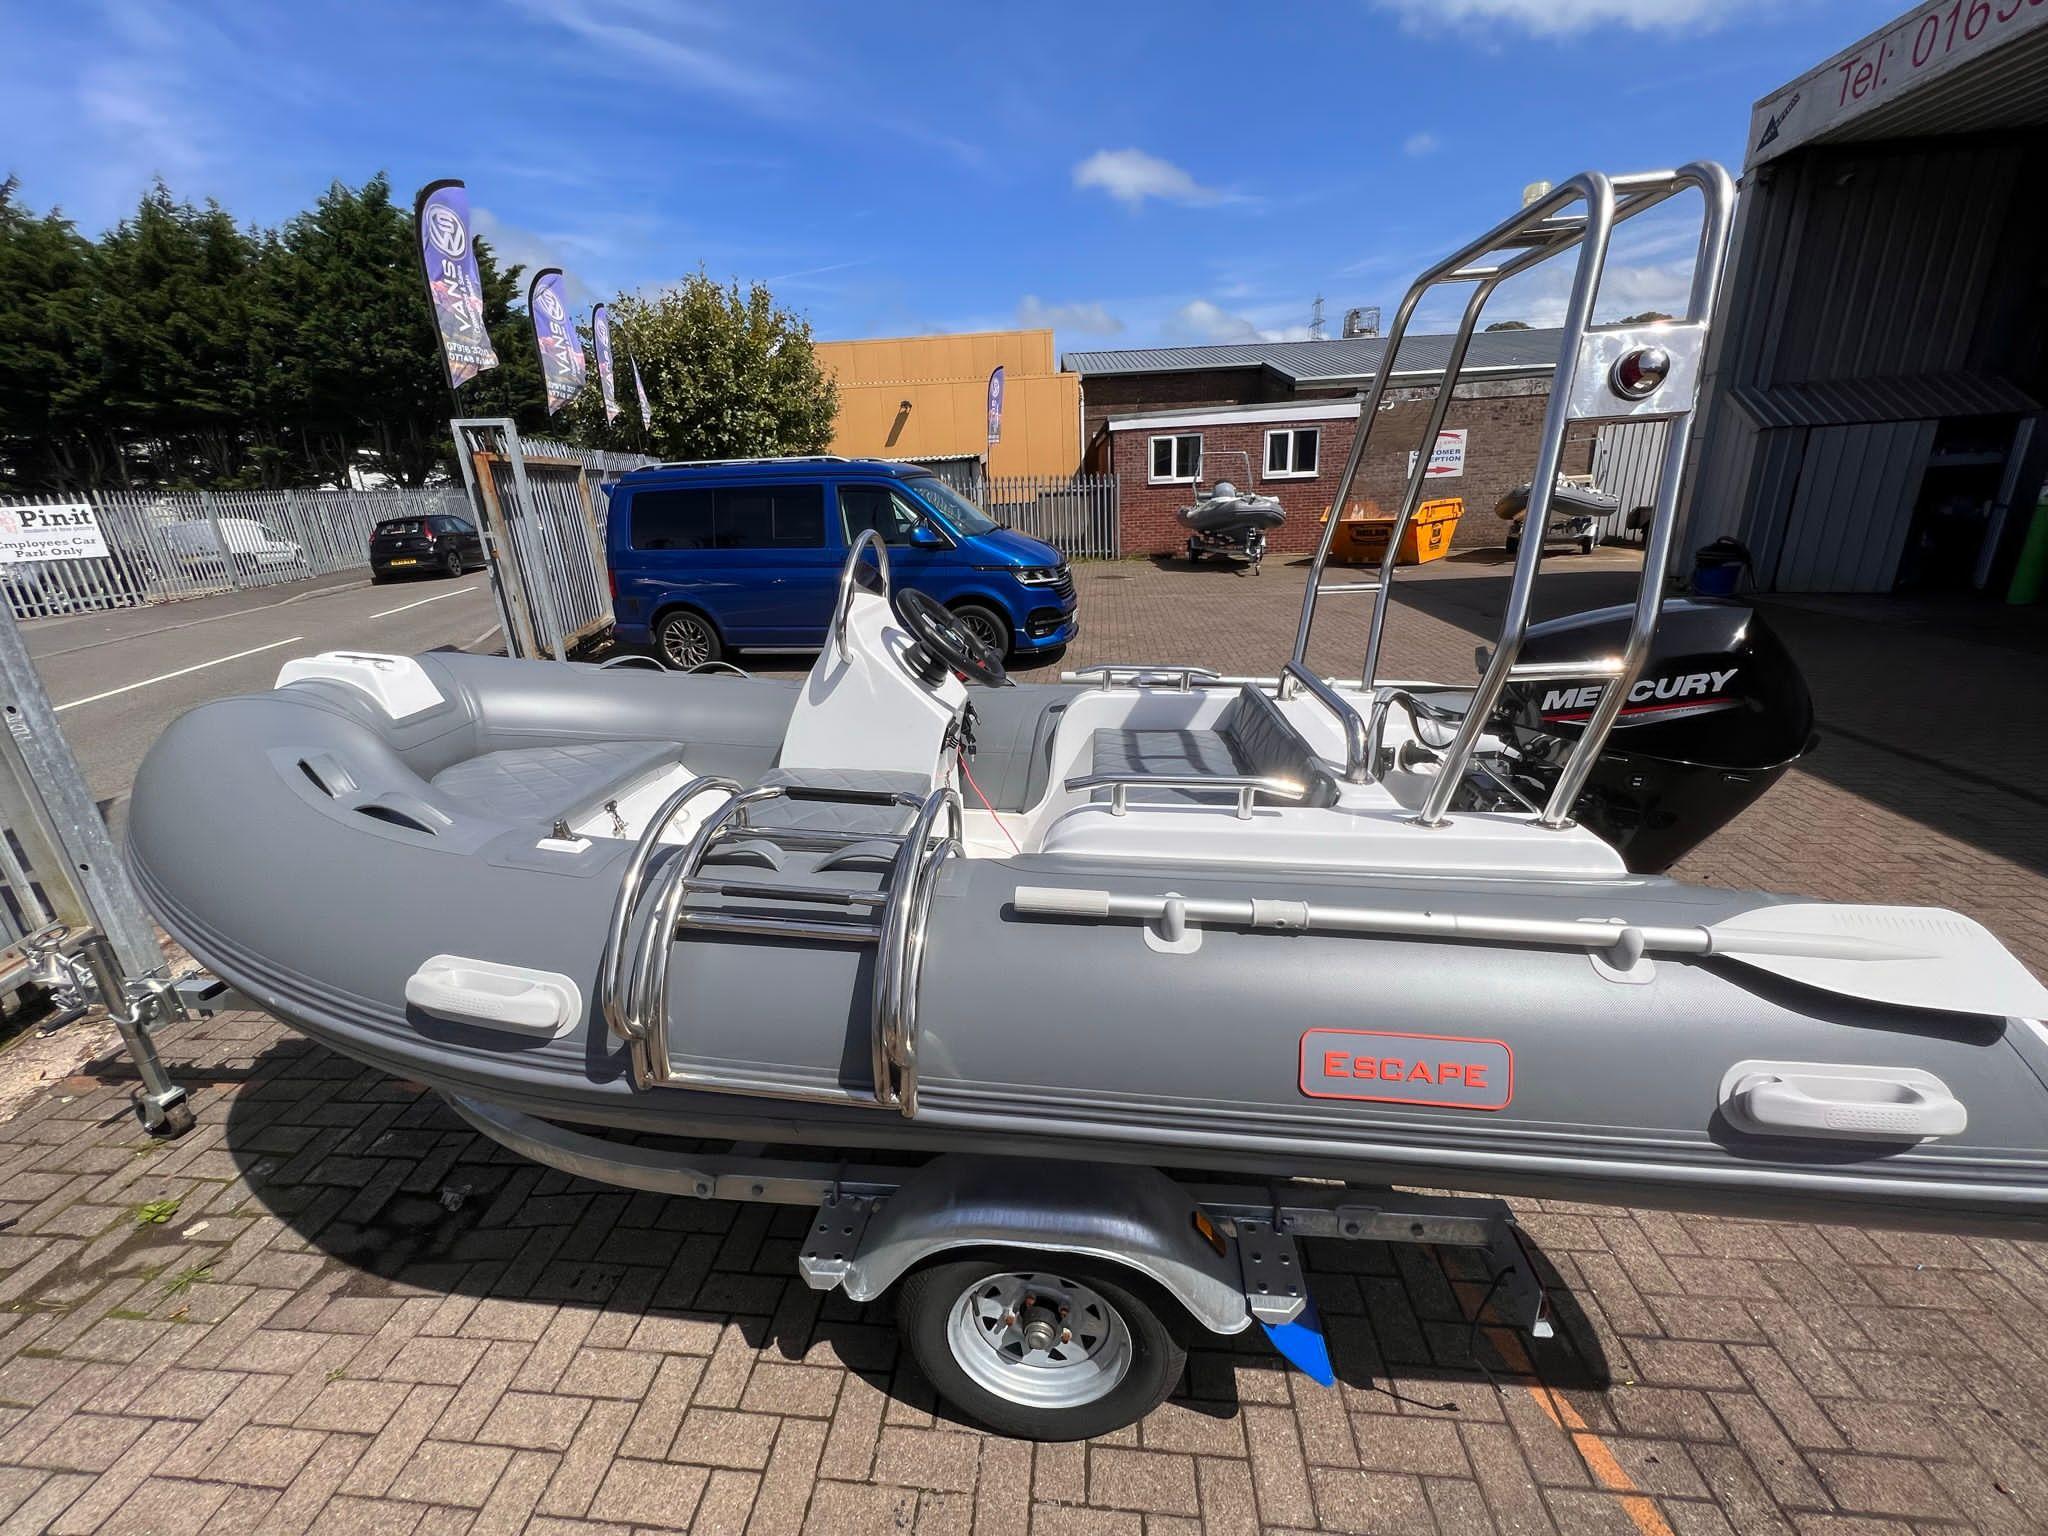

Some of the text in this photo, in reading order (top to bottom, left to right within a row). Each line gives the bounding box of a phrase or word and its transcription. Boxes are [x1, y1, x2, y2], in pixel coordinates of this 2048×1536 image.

[1839, 0, 2044, 107] Tel: 016
[441, 259, 472, 332] VANS
[549, 321, 571, 374] VANS
[15, 508, 92, 527] Pin-it
[15, 547, 82, 558] Park Only
[72, 537, 96, 545] Car
[1541, 668, 1738, 711] MECURY
[1324, 1051, 1489, 1088] ESCAPE
